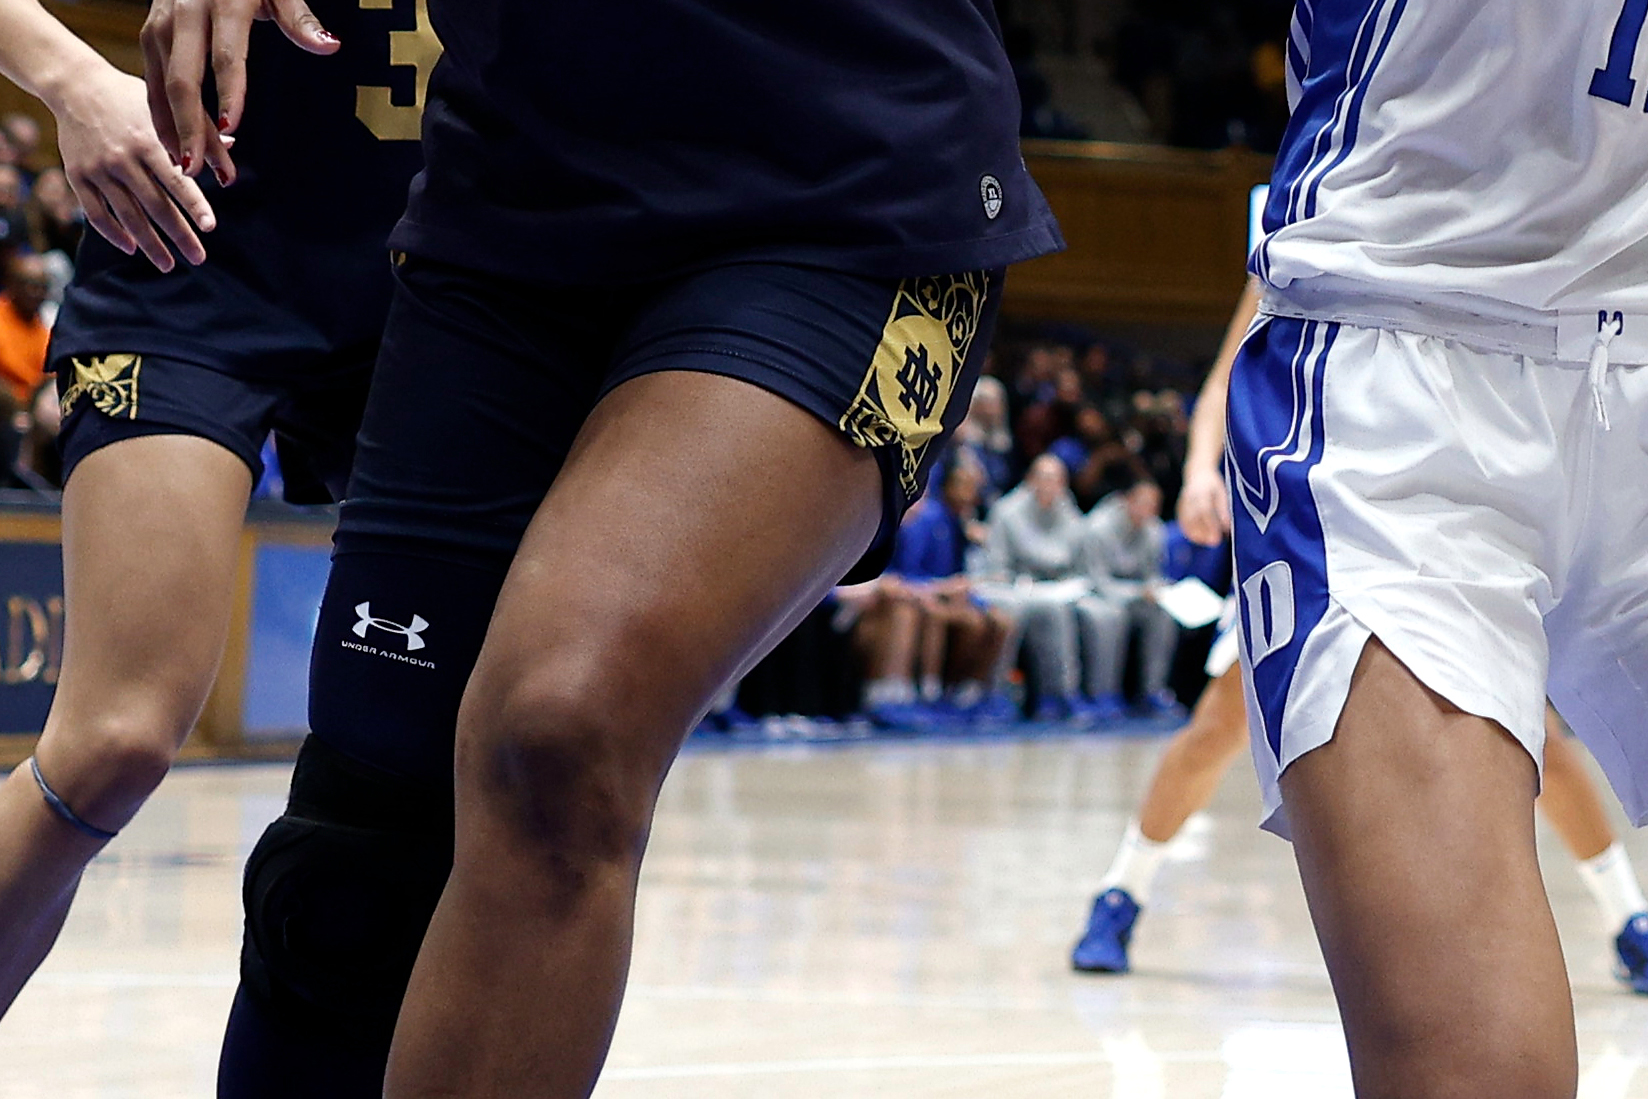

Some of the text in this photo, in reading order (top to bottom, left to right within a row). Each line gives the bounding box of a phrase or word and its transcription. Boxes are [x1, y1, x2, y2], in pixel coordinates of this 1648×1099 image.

[1242, 560, 1295, 667] D
[341, 640, 436, 670] UNDER ARMOUR
